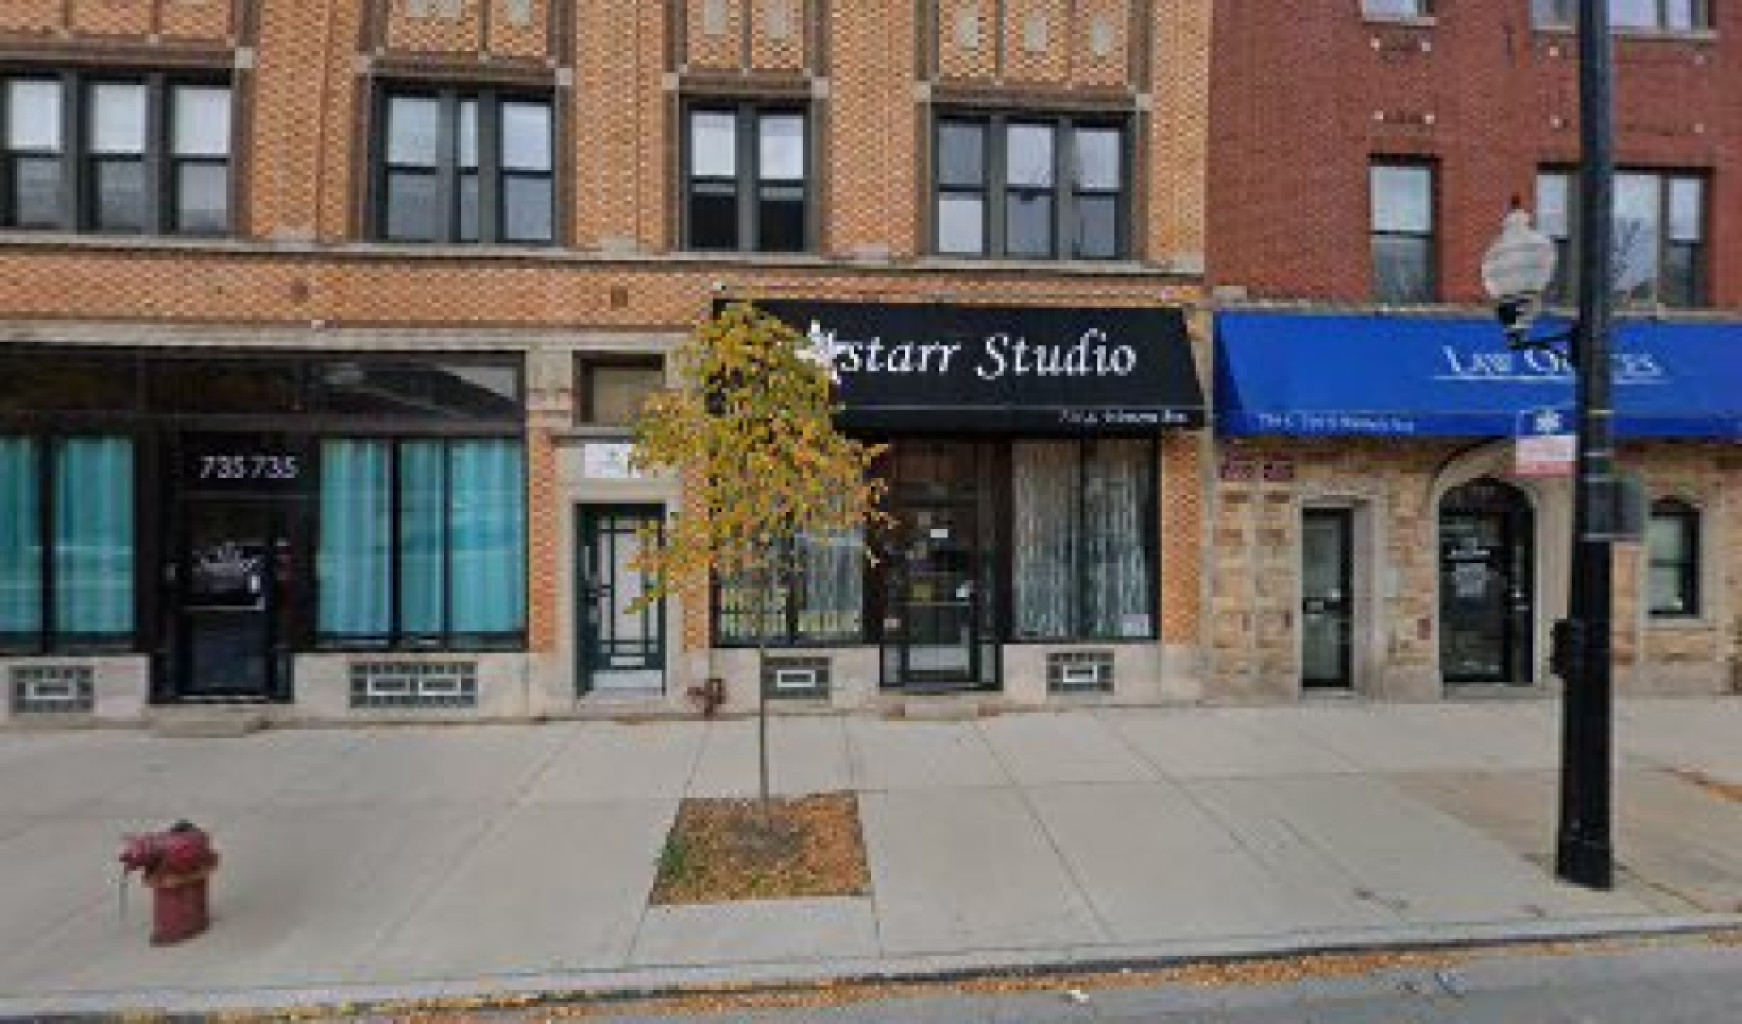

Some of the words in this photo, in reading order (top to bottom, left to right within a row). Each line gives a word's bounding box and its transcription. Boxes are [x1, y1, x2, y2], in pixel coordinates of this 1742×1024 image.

[976, 327, 1138, 381] Studio
[200, 455, 244, 479] 735
[251, 455, 300, 479] 735
